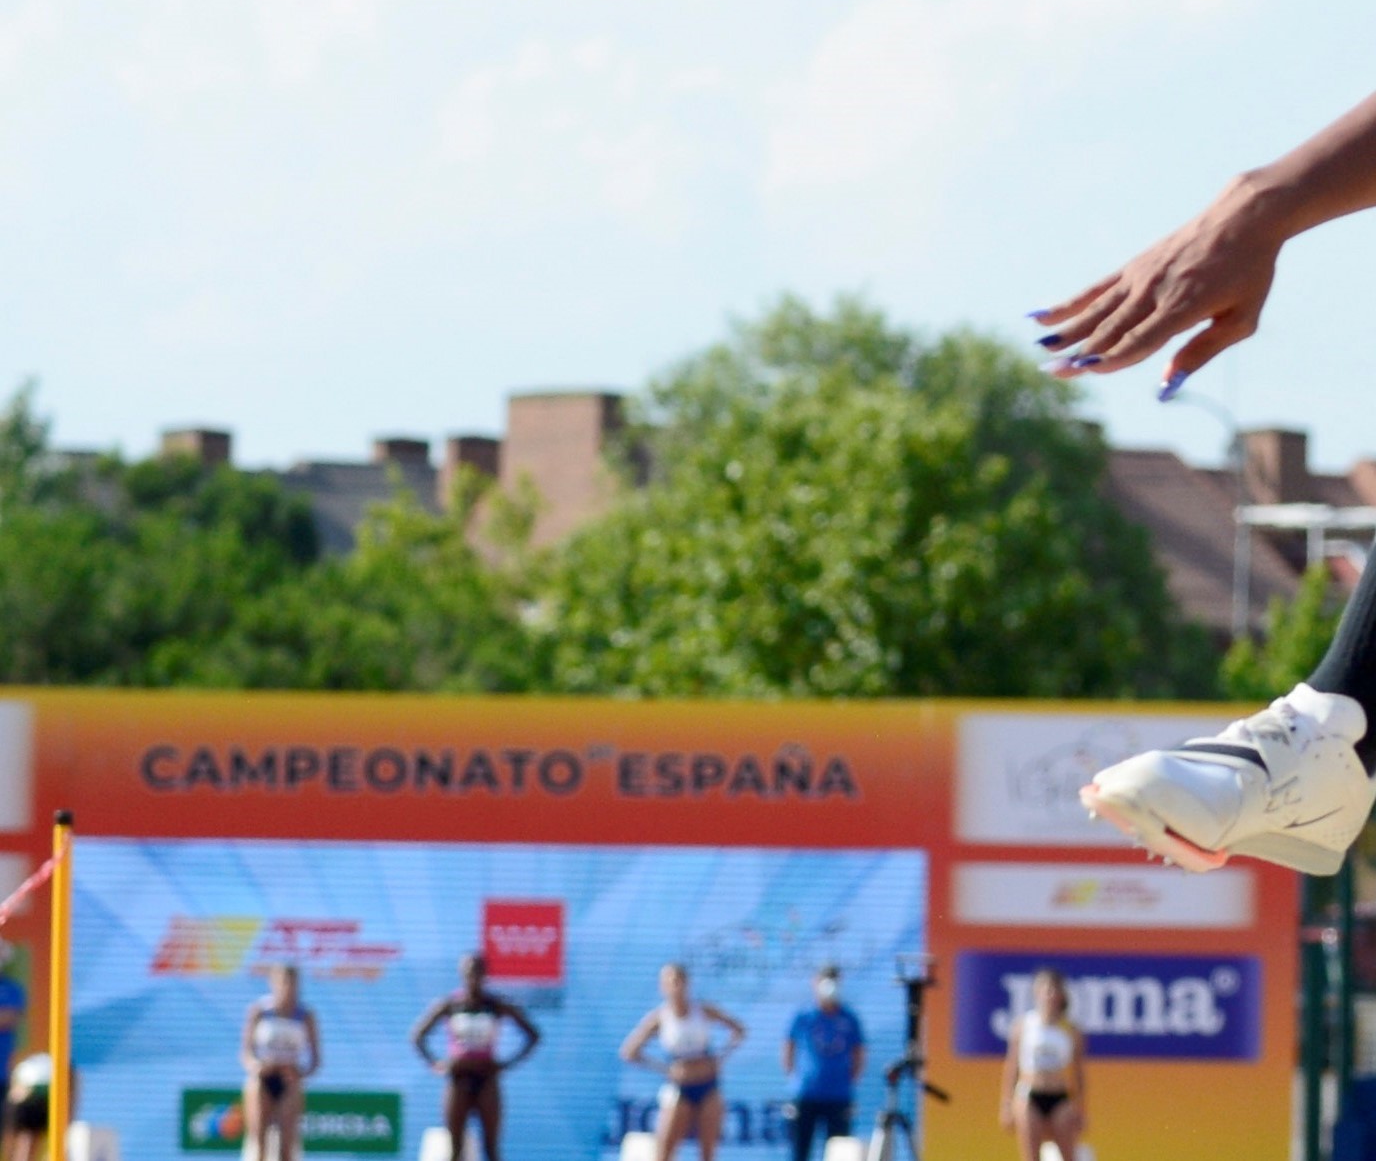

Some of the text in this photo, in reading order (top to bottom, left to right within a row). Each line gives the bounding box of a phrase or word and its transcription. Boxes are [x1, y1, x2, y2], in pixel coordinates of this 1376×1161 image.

[140, 743, 860, 797] CAMPEONATO ESPAÑA
[989, 973, 1227, 1038] Jma
